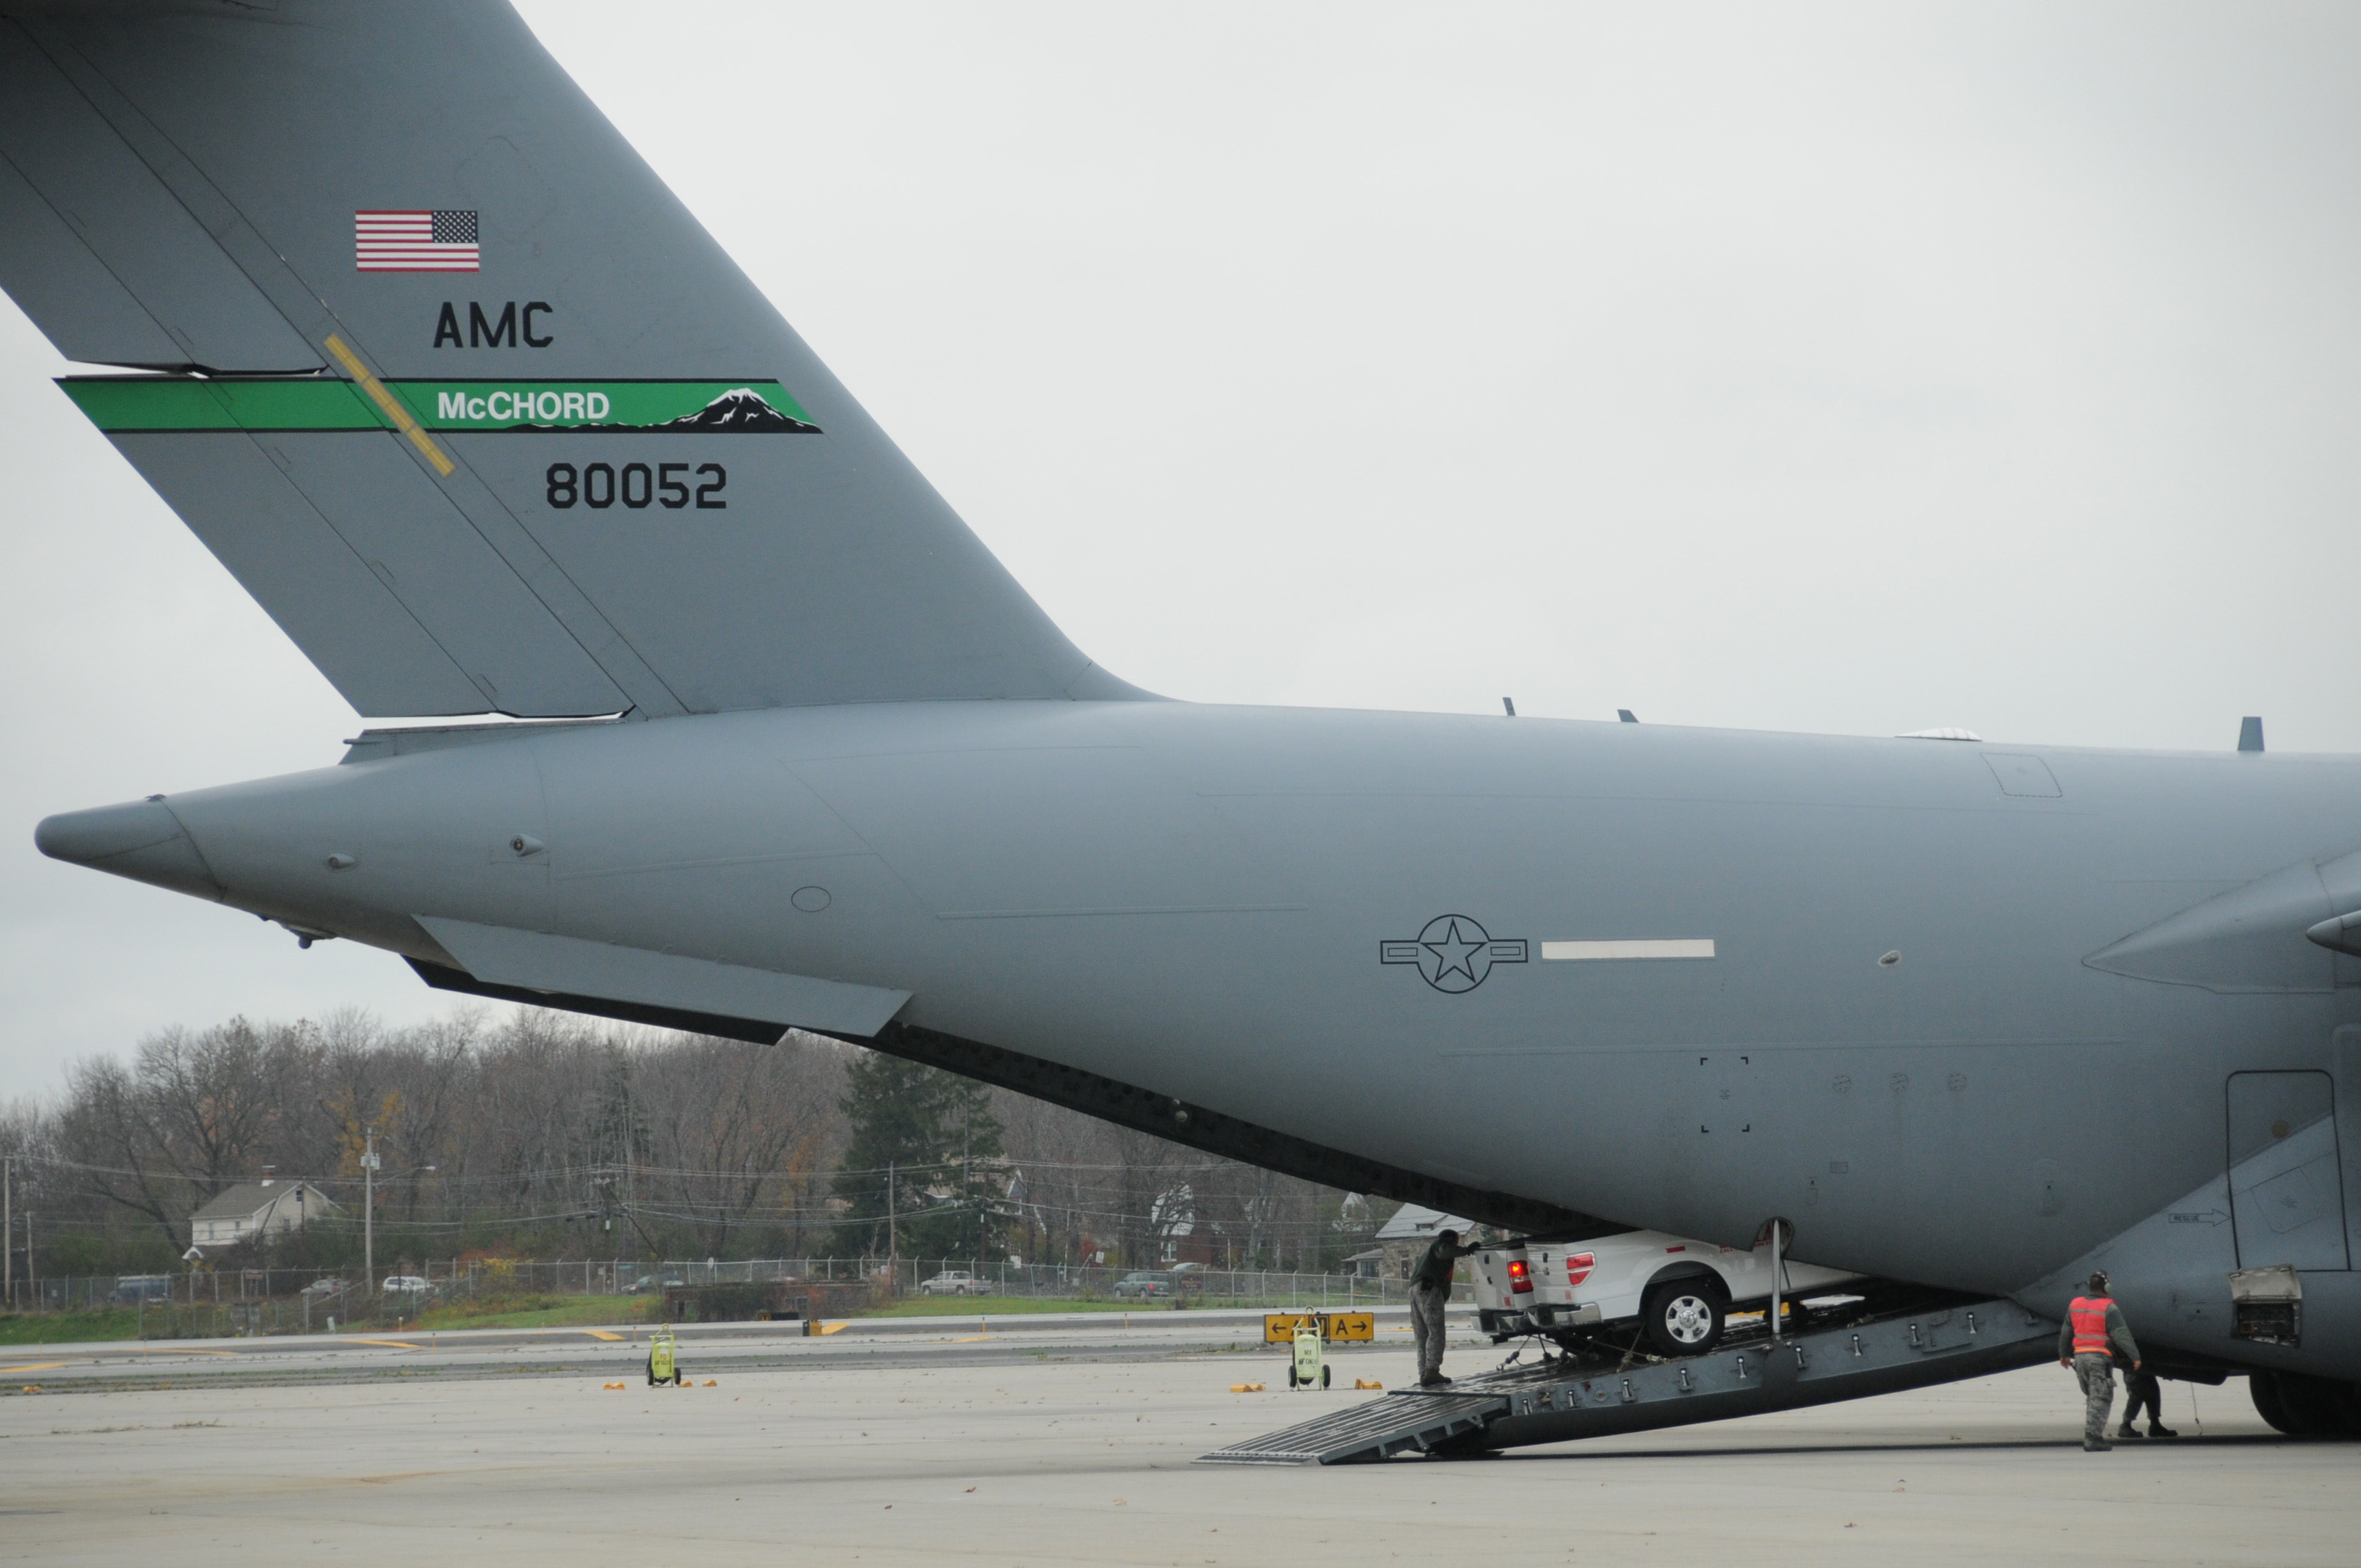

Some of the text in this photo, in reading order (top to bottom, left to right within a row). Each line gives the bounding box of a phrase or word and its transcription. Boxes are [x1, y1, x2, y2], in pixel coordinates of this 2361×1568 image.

[432, 301, 554, 348] AMC
[438, 392, 610, 420] McCHORD
[546, 463, 727, 509] 80052
[1335, 1319, 1349, 1335] A
